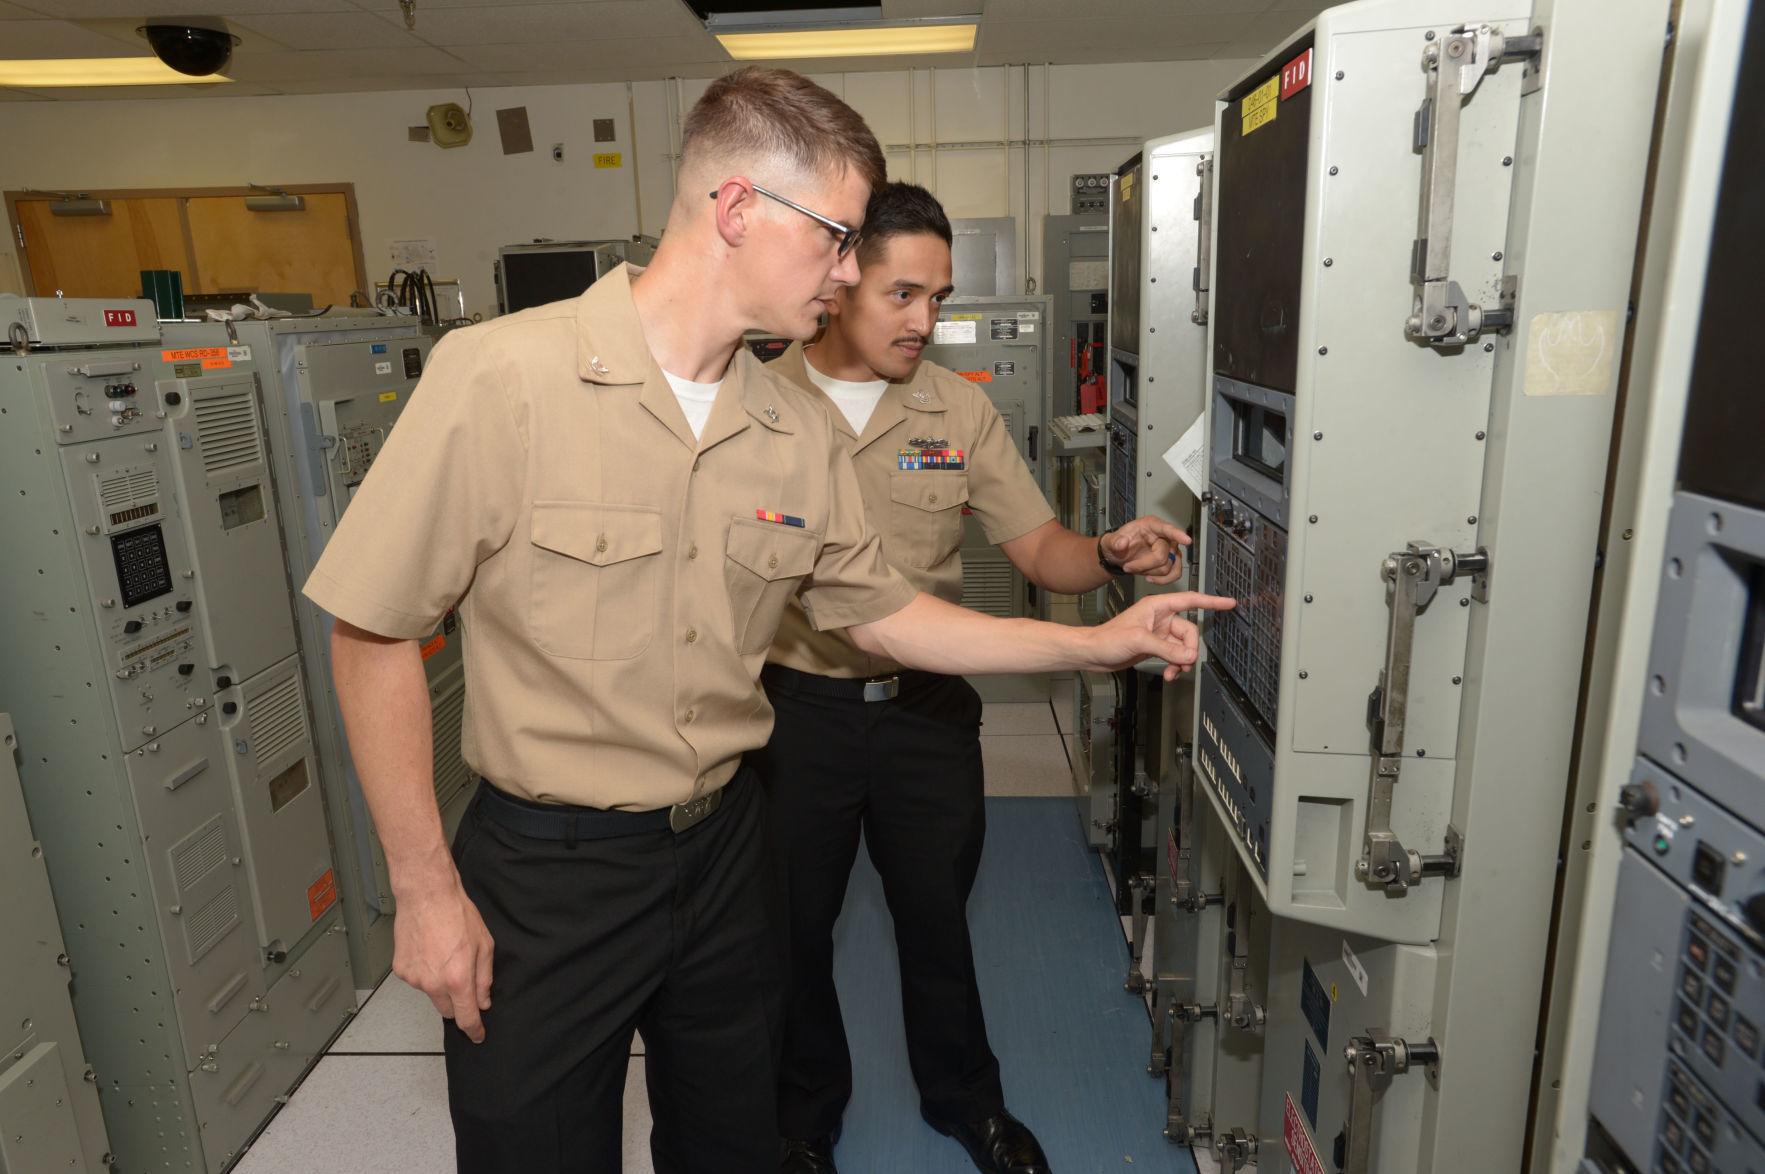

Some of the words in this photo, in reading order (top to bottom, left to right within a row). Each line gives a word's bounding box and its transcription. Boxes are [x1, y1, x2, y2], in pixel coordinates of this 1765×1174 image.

[1284, 61, 1306, 90] FID
[598, 155, 616, 166] FIRE
[108, 312, 132, 323] FID
